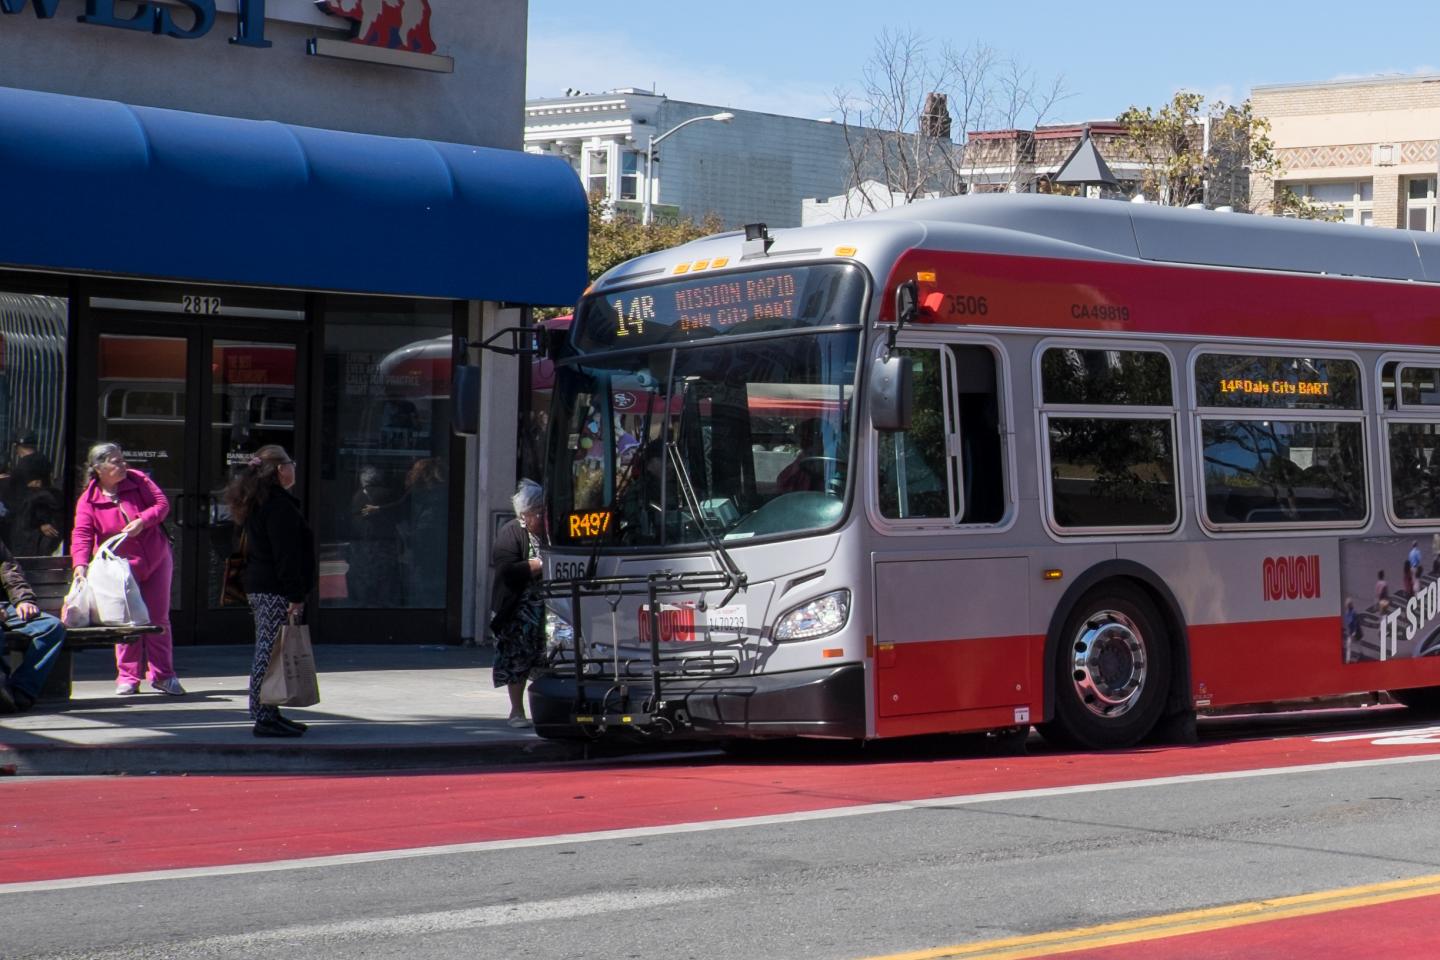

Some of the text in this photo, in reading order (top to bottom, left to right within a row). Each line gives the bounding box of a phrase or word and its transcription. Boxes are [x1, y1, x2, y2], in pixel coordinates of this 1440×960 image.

[675, 274, 795, 311] MISSION RAPID
[183, 297, 220, 314] 2812
[680, 300, 792, 330] Daly City BART
[1071, 303, 1130, 321] CA49819
[1244, 381, 1269, 394] Daly
[1272, 382, 1296, 394] City
[1298, 382, 1329, 395] BART
[569, 511, 611, 537] R497
[555, 562, 586, 580] 6506
[1379, 607, 1401, 662] IT
